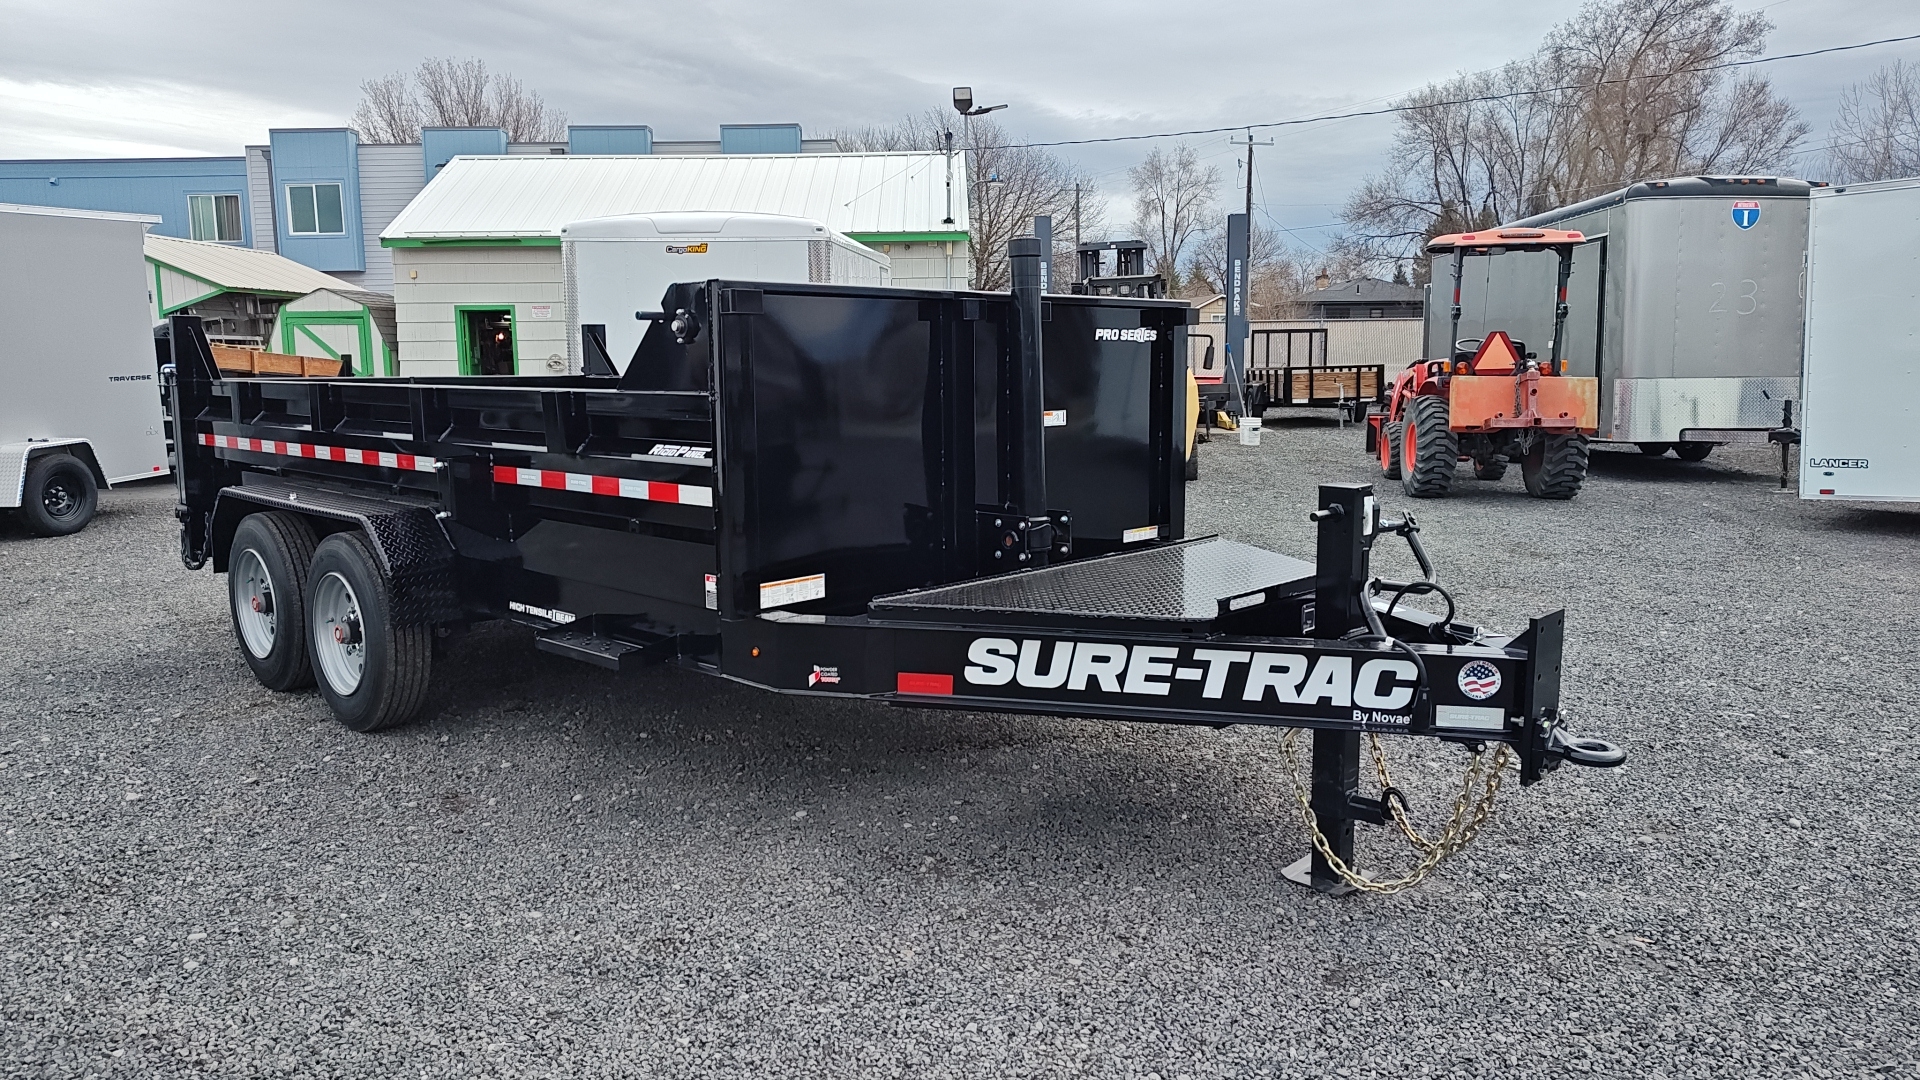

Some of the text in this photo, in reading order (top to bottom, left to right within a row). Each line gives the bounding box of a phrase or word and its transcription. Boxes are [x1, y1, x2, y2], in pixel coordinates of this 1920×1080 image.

[1095, 327, 1157, 342] PRO SERIES
[108, 374, 152, 382] TRAVERSE
[1810, 458, 1869, 469] LANCER
[509, 600, 525, 613] HIGH
[525, 604, 553, 619] TENSILE
[963, 637, 1419, 710] SURE-TRAC
[1352, 709, 1369, 724] By
